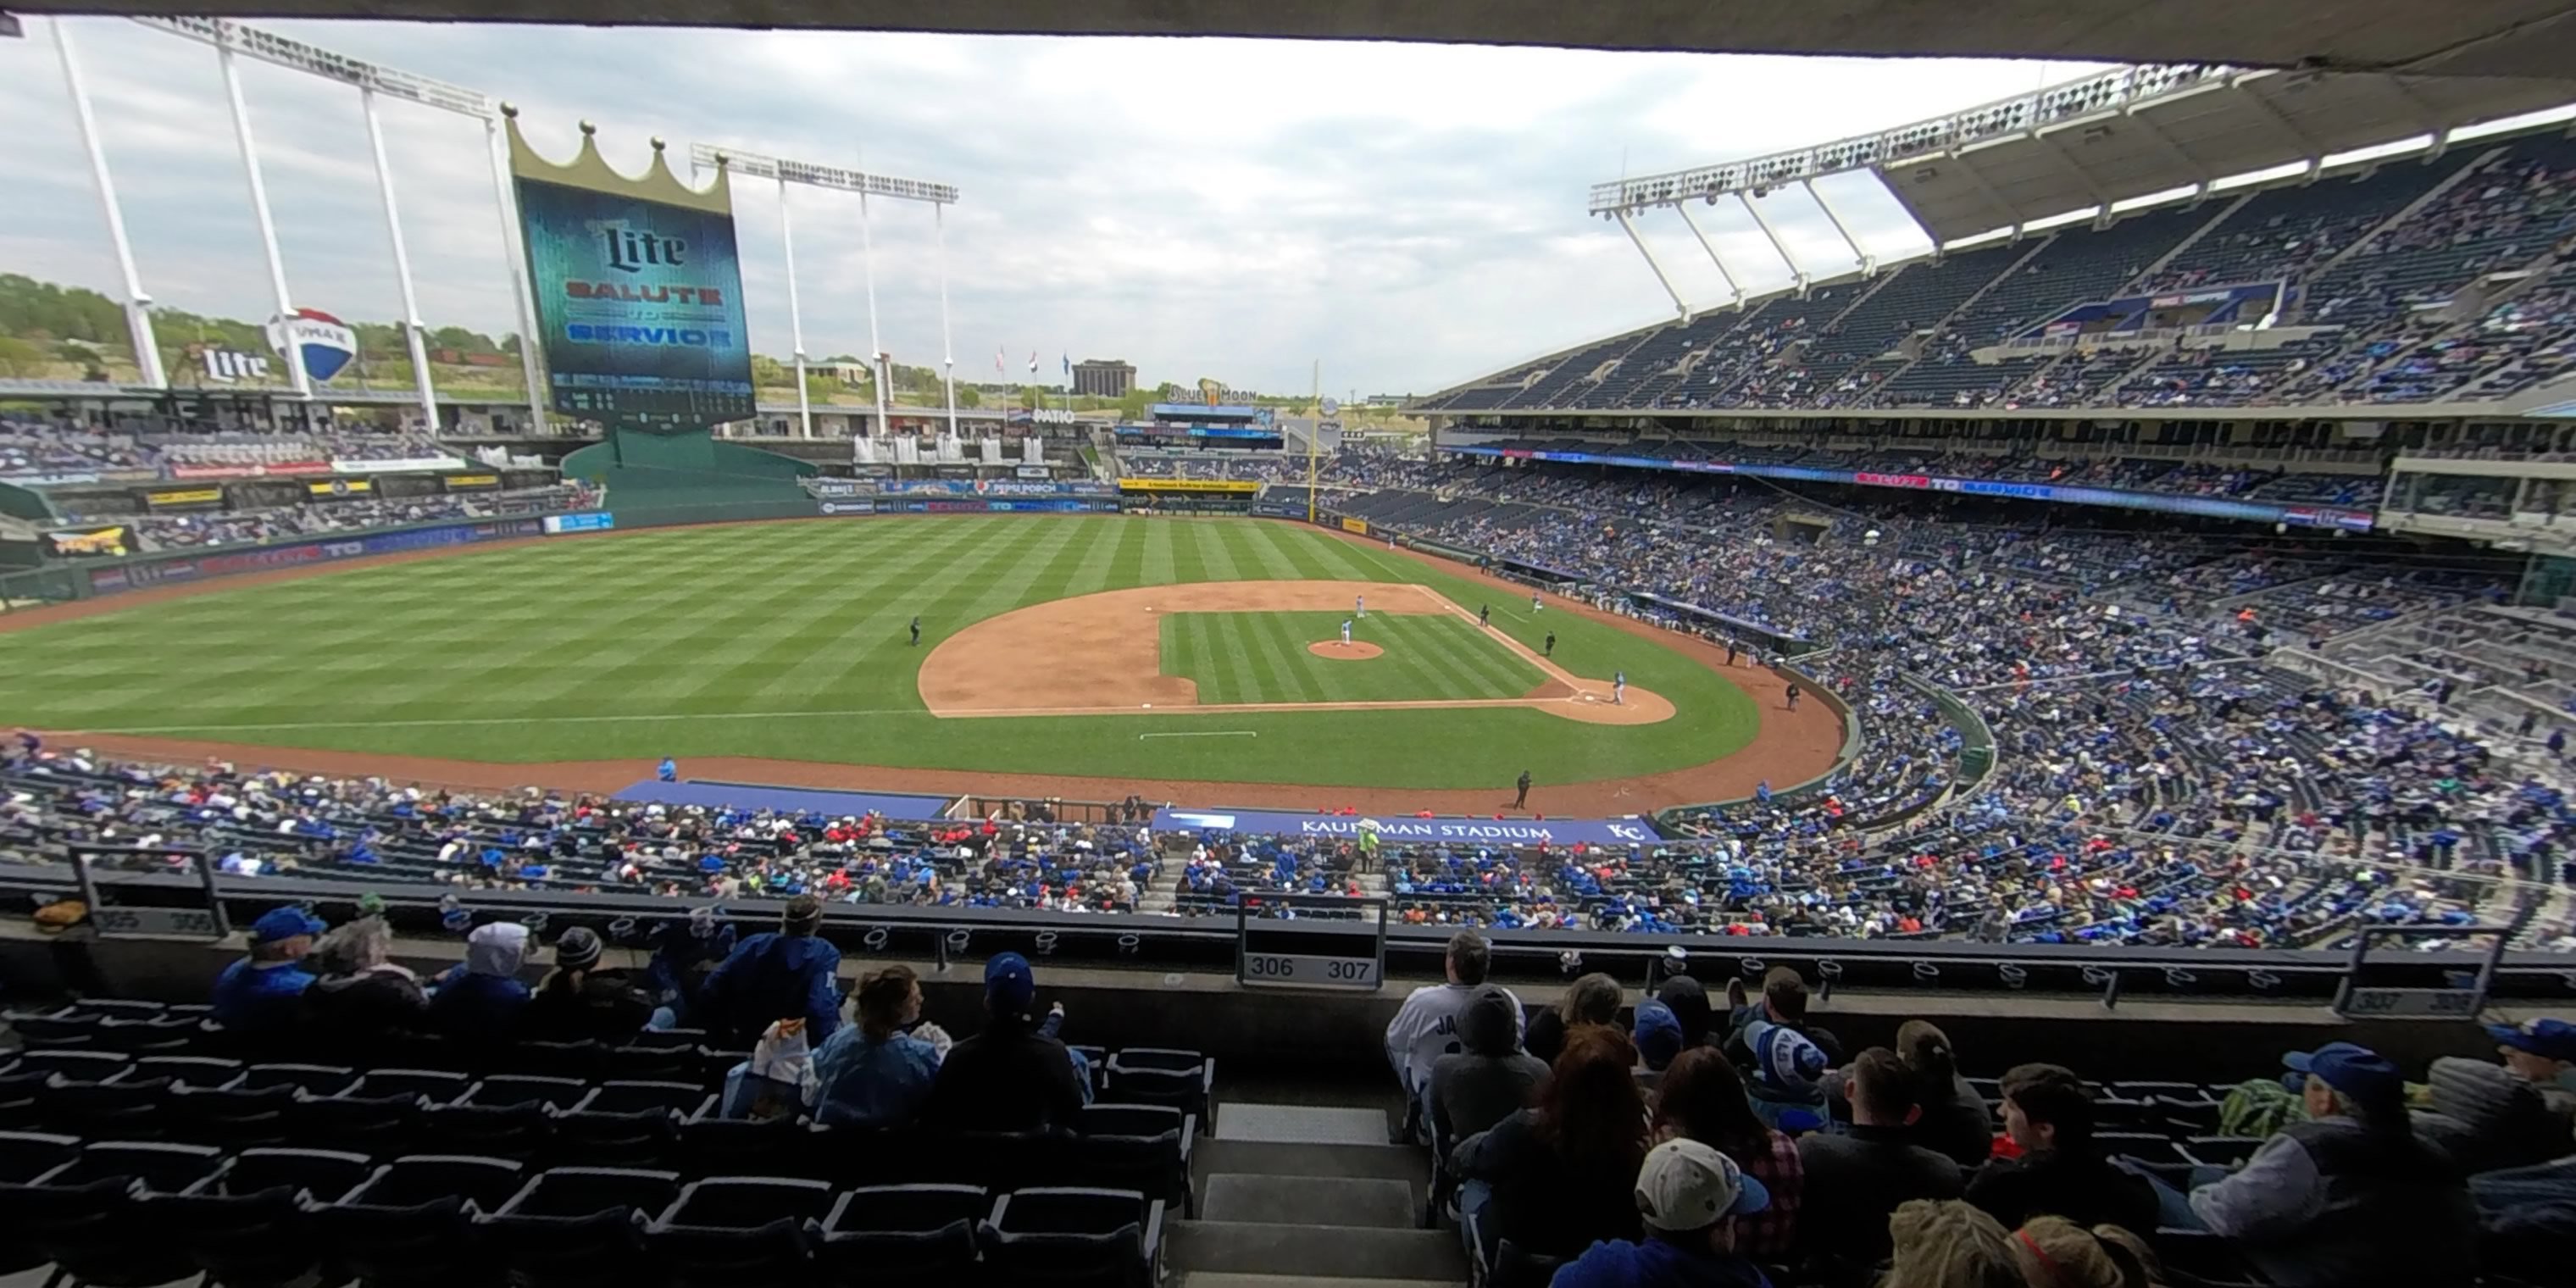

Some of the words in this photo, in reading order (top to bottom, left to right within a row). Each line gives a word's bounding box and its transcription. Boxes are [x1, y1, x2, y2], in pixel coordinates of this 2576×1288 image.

[589, 219, 687, 273] Lite
[565, 280, 724, 306] SALUTE
[567, 324, 732, 347] SERVICE
[203, 349, 269, 383] Lite
[1168, 384, 1203, 403] BLUE
[1221, 387, 1257, 402] MOON
[1032, 409, 1075, 423] PATIO
[1931, 479, 1960, 491] TO
[1302, 820, 1433, 836] KAUFMAN
[1441, 824, 1552, 840] STADIUM
[1607, 824, 1646, 841] KC
[1251, 957, 1294, 976] 306
[1327, 960, 1370, 980] 307
[1436, 1014, 1457, 1035] JA
